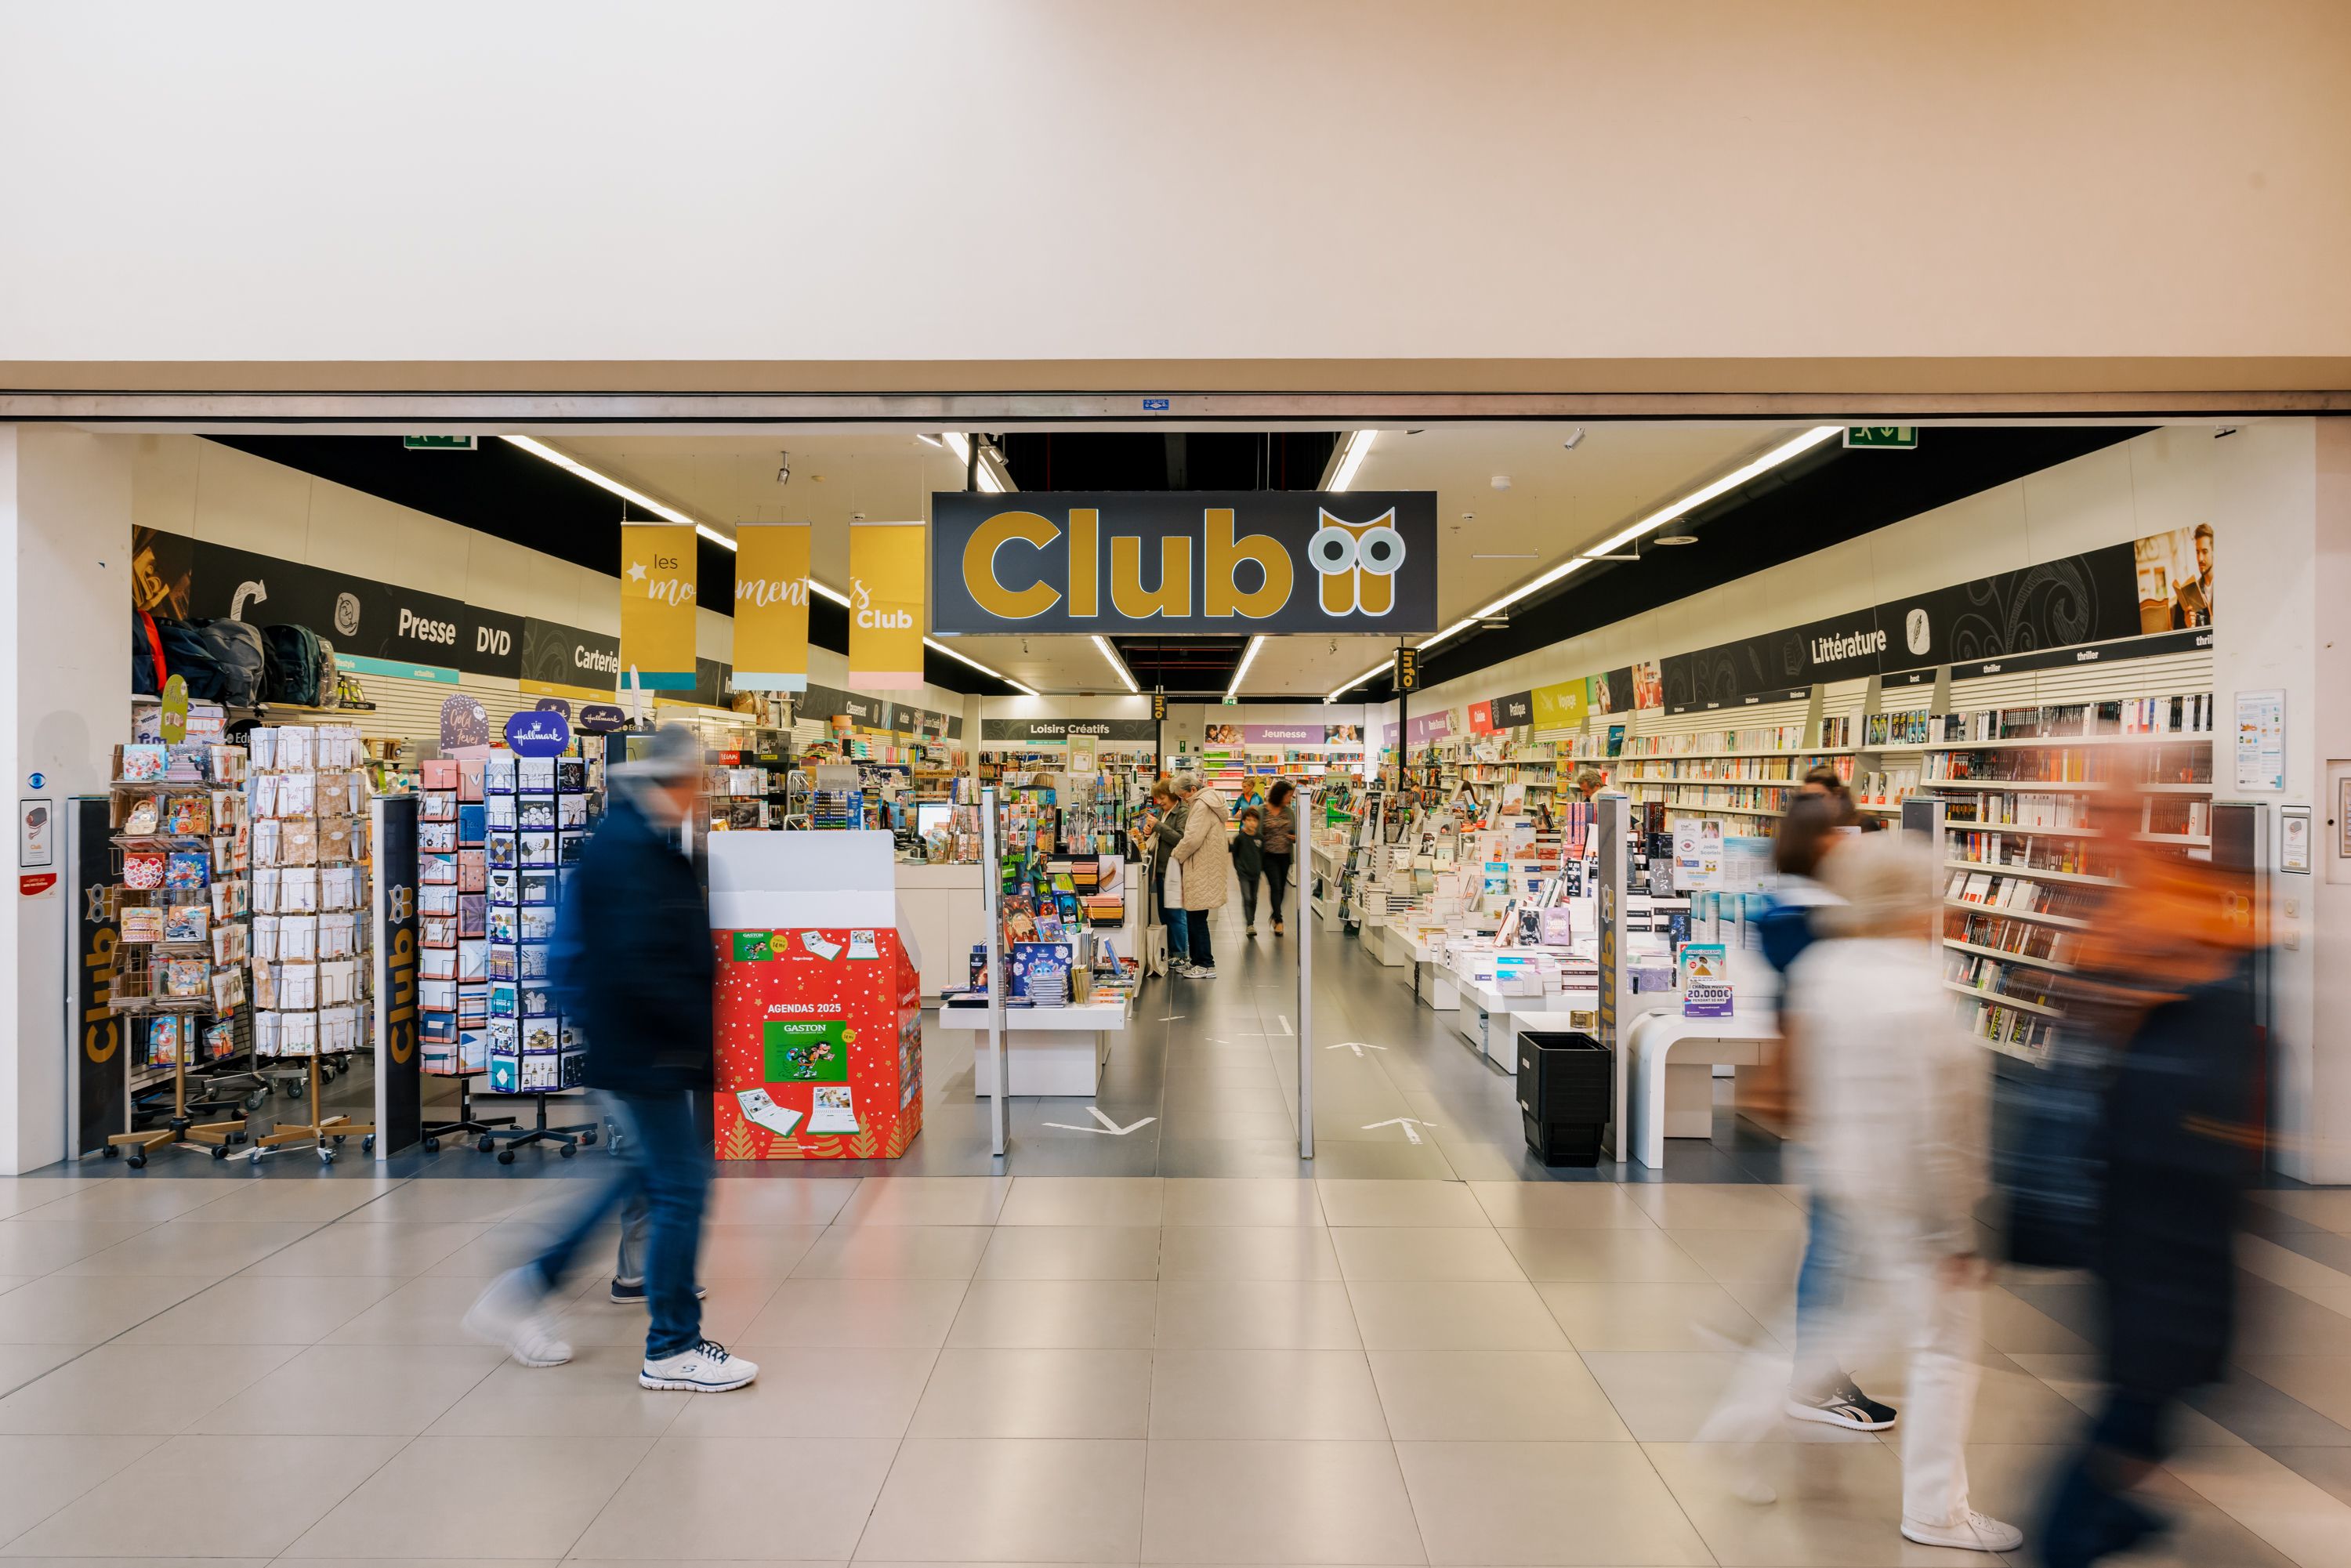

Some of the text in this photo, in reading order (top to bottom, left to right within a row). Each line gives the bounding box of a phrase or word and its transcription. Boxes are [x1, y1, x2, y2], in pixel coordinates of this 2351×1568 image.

[654, 554, 678, 570] les
[962, 508, 1294, 619] Club
[398, 608, 456, 645] Presse
[857, 609, 913, 629] Club
[476, 626, 511, 656] DVD
[1811, 629, 1887, 664] Littérature
[2196, 634, 2213, 646] thril
[574, 645, 618, 673] Carterie
[2077, 650, 2099, 661] thriller
[1402, 649, 1414, 688] info
[1983, 664, 2001, 673] thriller
[1155, 696, 1164, 719] info
[1509, 703, 1526, 718] Pratique
[1557, 693, 1577, 710] Voyage
[450, 708, 471, 730] Gold
[584, 714, 620, 723] Hallmark
[457, 729, 479, 744] Fever
[513, 728, 563, 746] Hallmark
[1031, 723, 1110, 733] Loisirs Créatifs
[1262, 730, 1306, 738] Jeunesse
[86, 928, 118, 1063] Club
[389, 928, 414, 1063] Club
[768, 1004, 841, 1013] AGENDAS 2025
